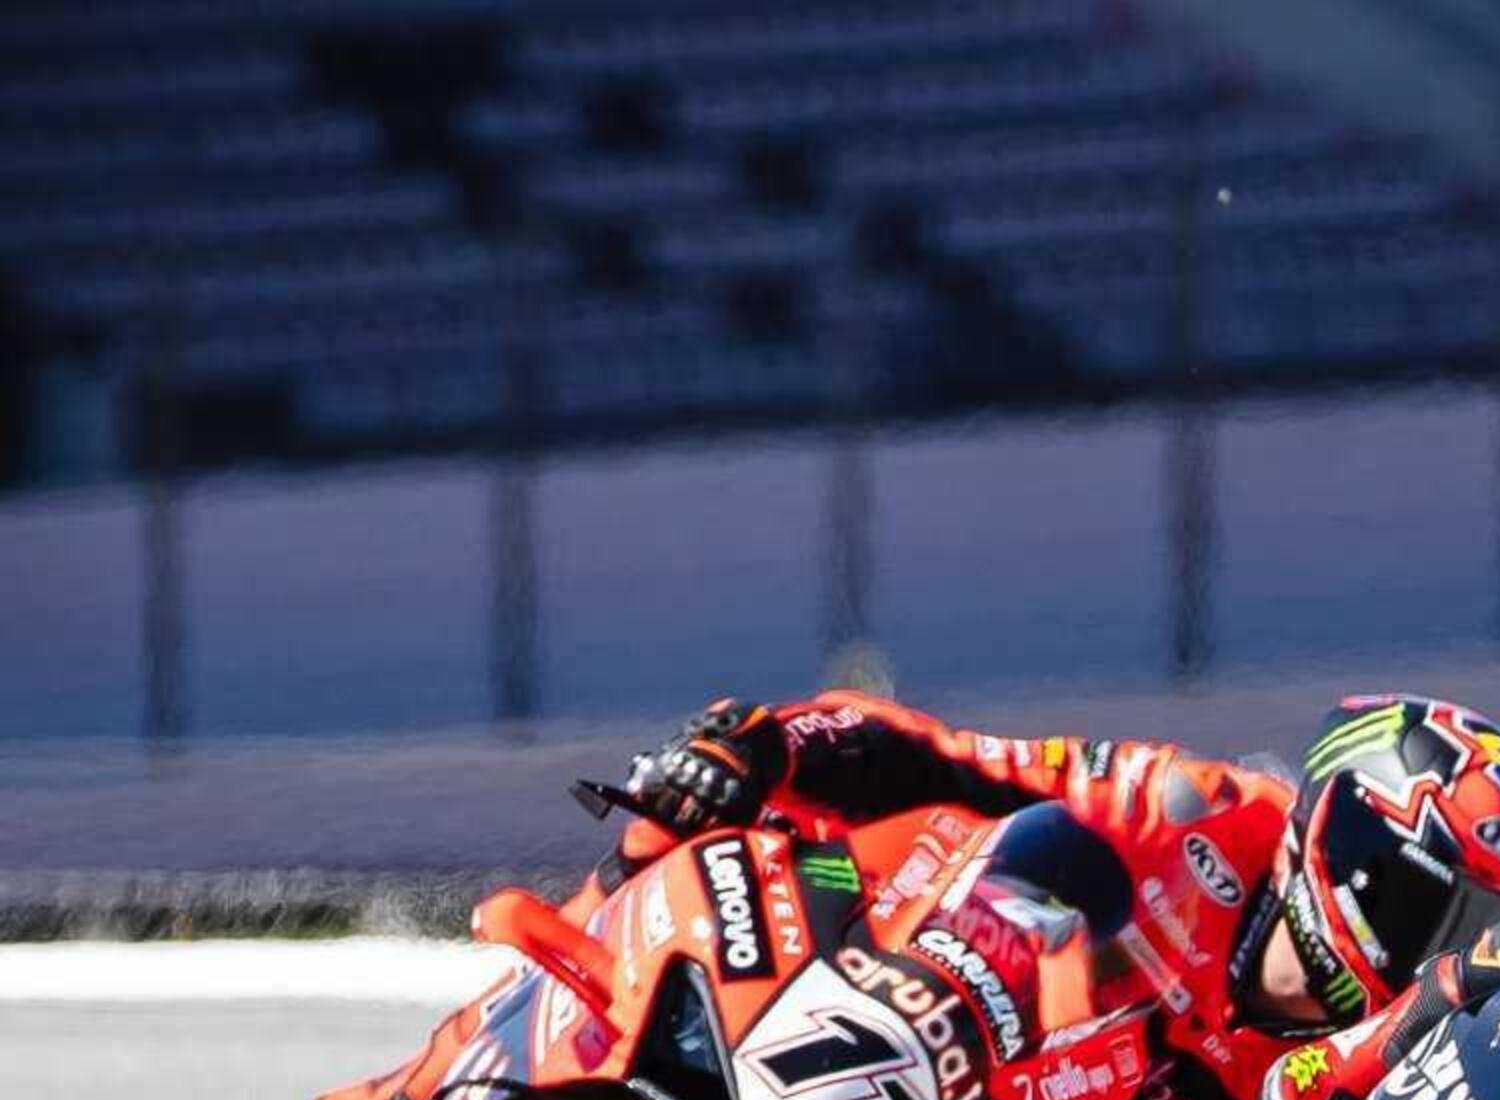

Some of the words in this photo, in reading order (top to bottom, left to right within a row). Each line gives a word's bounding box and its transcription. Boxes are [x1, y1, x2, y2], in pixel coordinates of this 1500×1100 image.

[703, 840, 759, 968] Lenovo
[757, 834, 804, 955] ALTEN
[916, 928, 1026, 1062] CARRERA
